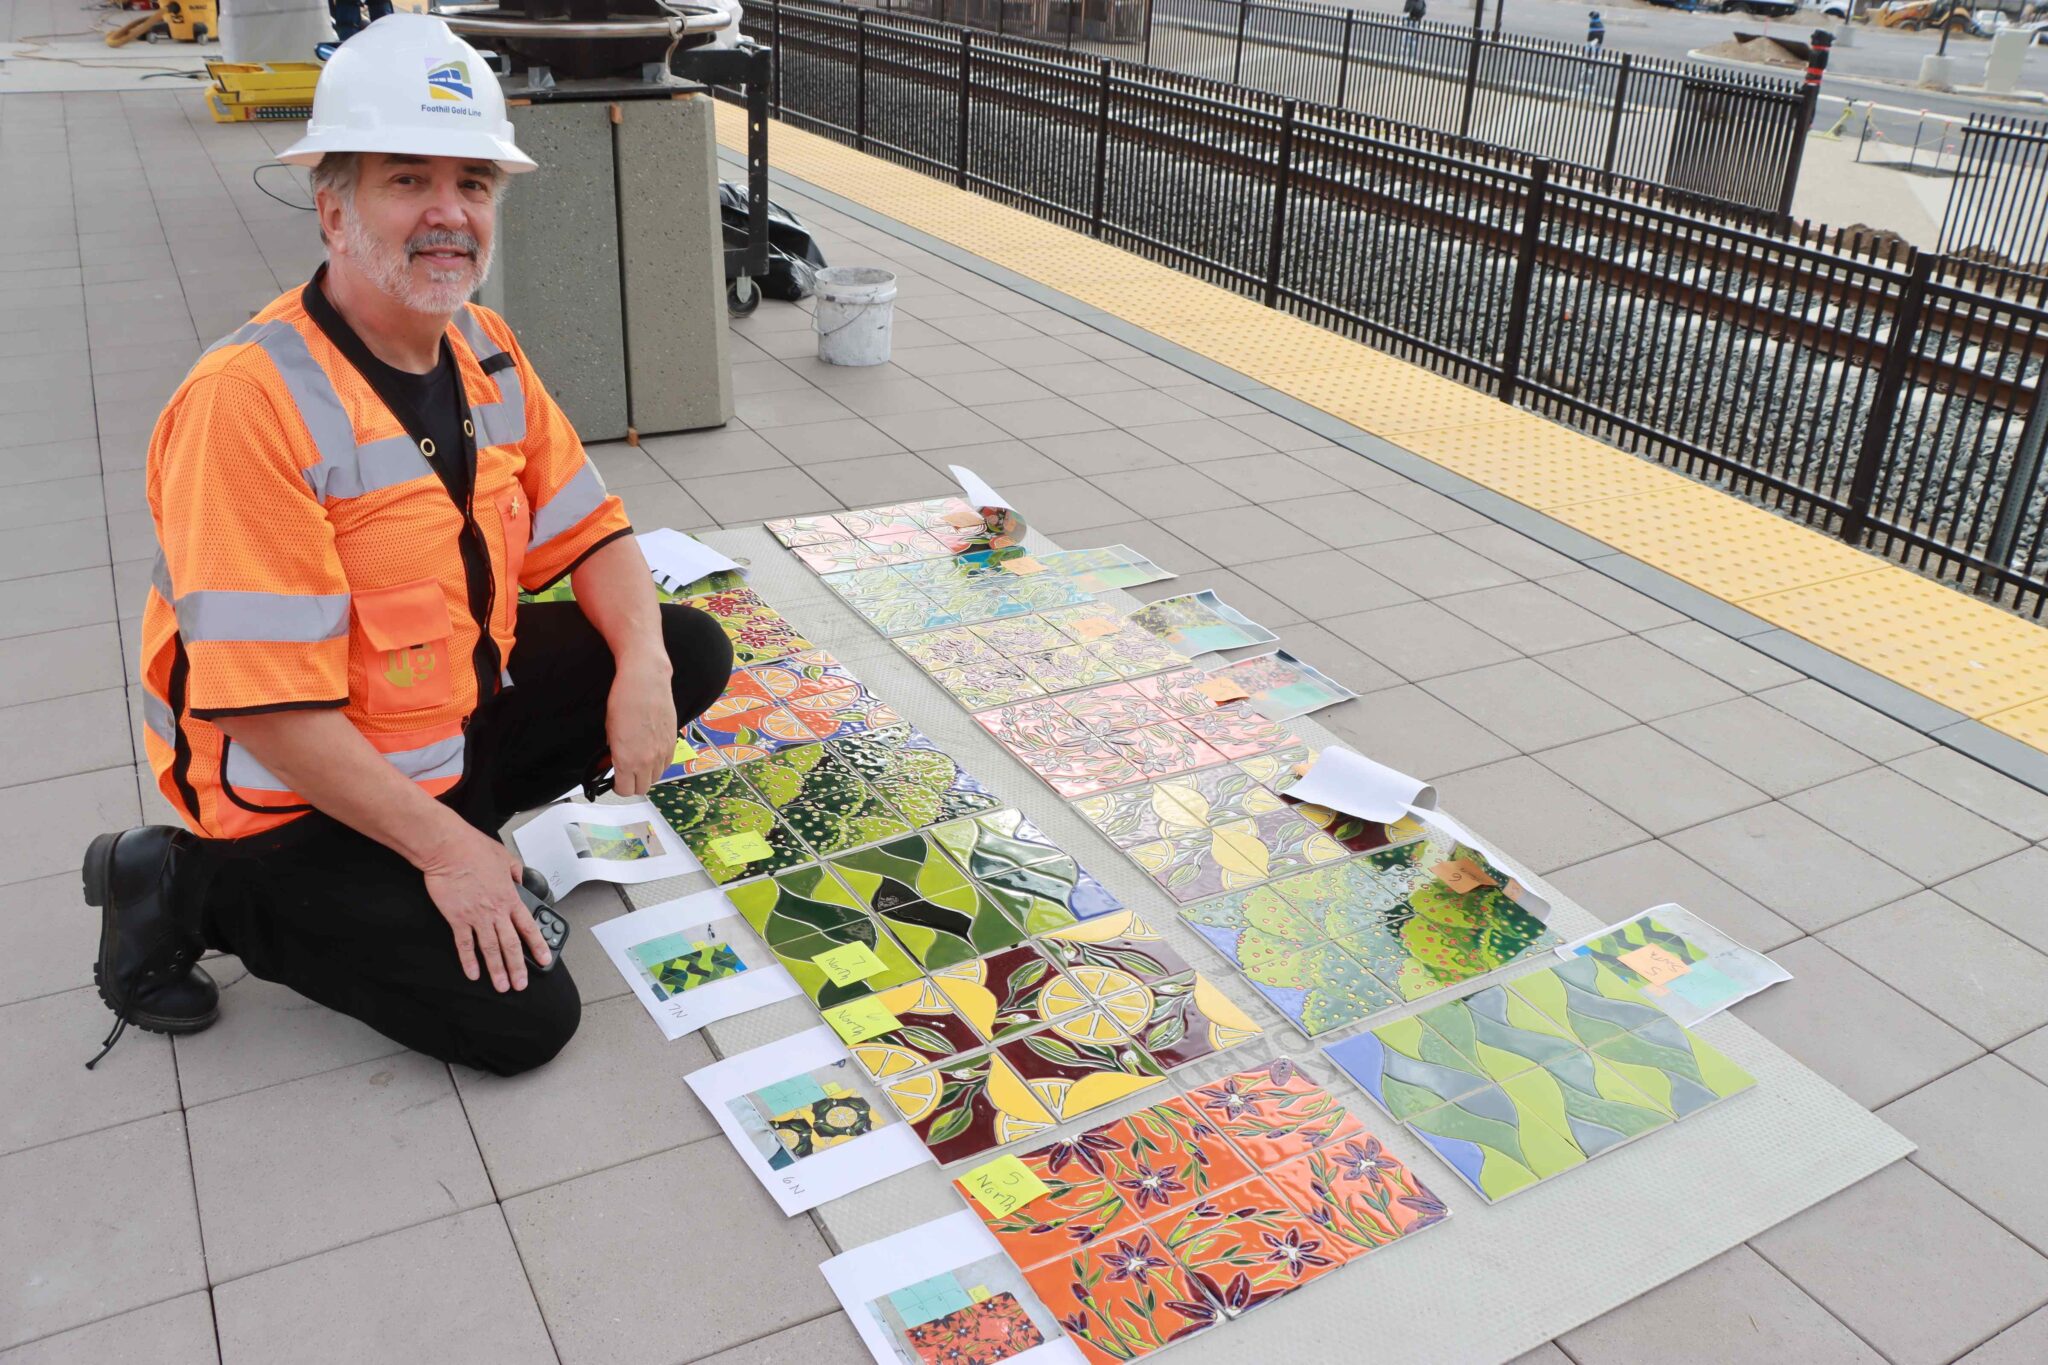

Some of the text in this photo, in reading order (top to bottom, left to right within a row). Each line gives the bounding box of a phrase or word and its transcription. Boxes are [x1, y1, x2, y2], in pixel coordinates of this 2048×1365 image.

[421, 104, 482, 118] Foothill Gold Line
[1002, 1171, 1024, 1186] 5
